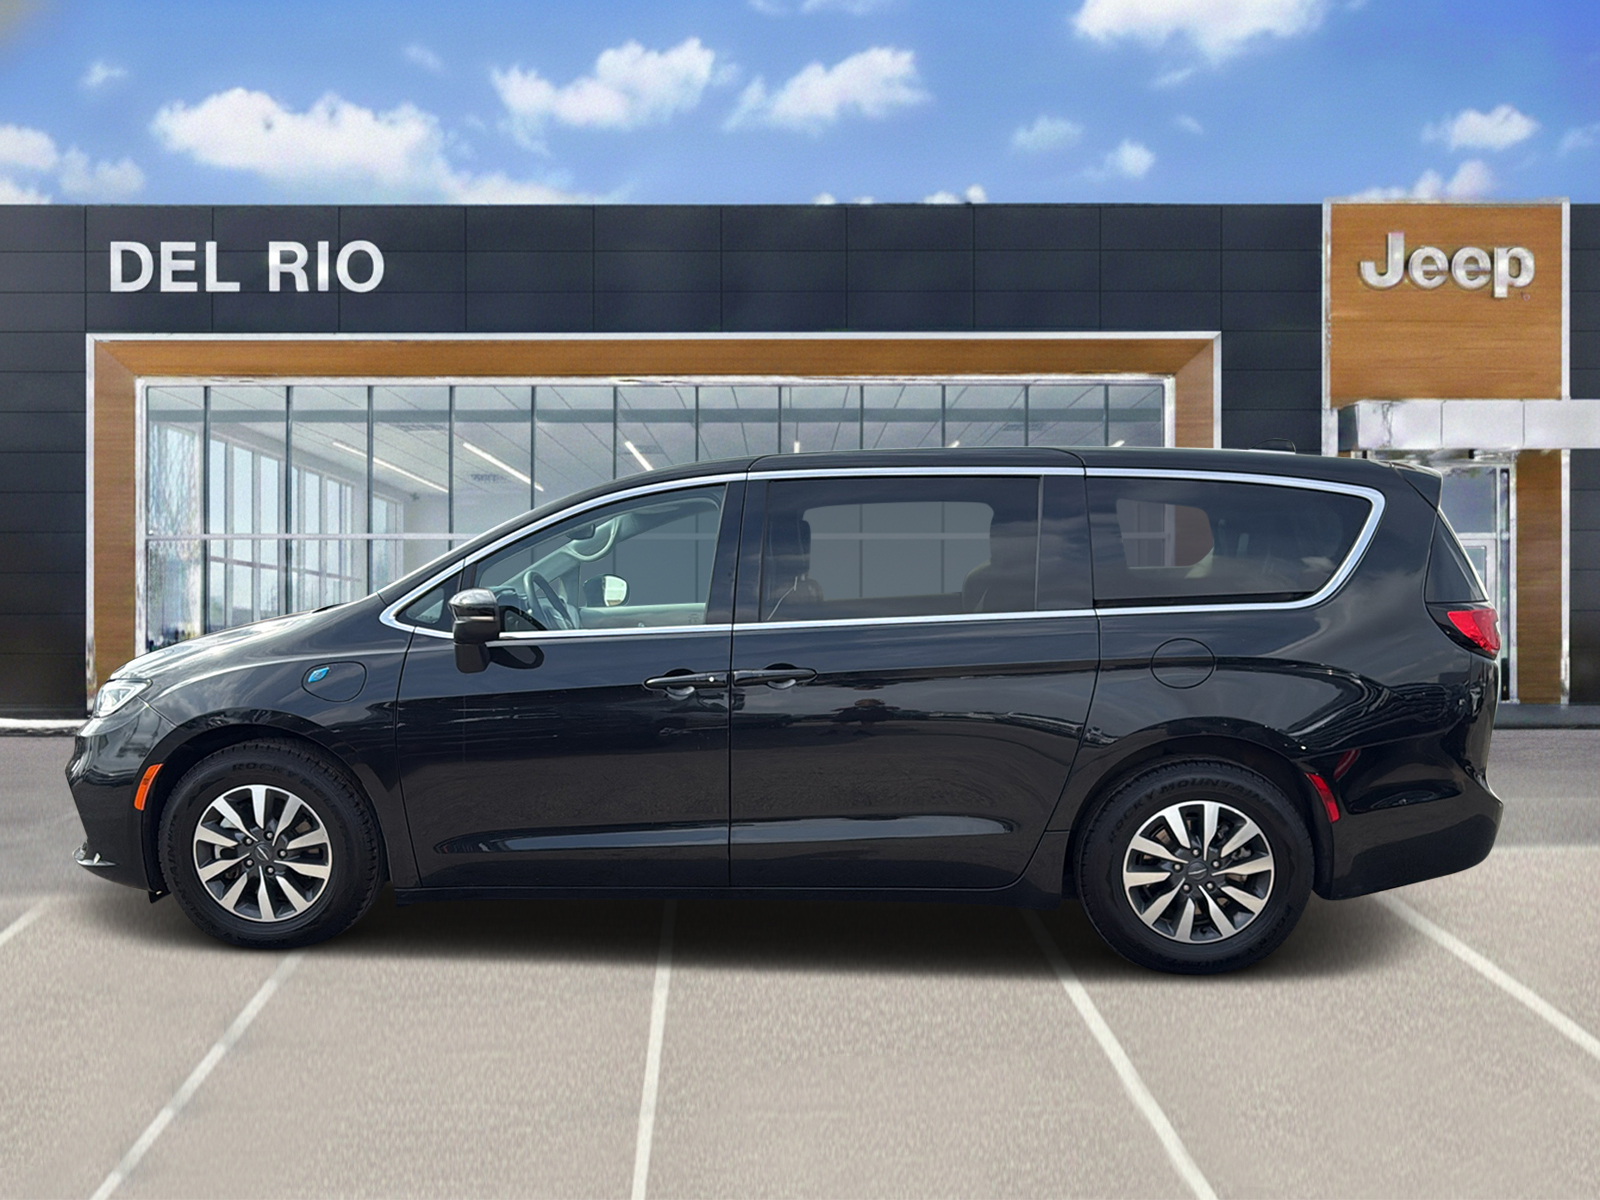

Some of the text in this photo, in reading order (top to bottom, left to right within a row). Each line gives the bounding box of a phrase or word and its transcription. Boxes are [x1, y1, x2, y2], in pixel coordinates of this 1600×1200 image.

[110, 239, 385, 293] DEL RIO
[1359, 231, 1535, 298] Jeep
